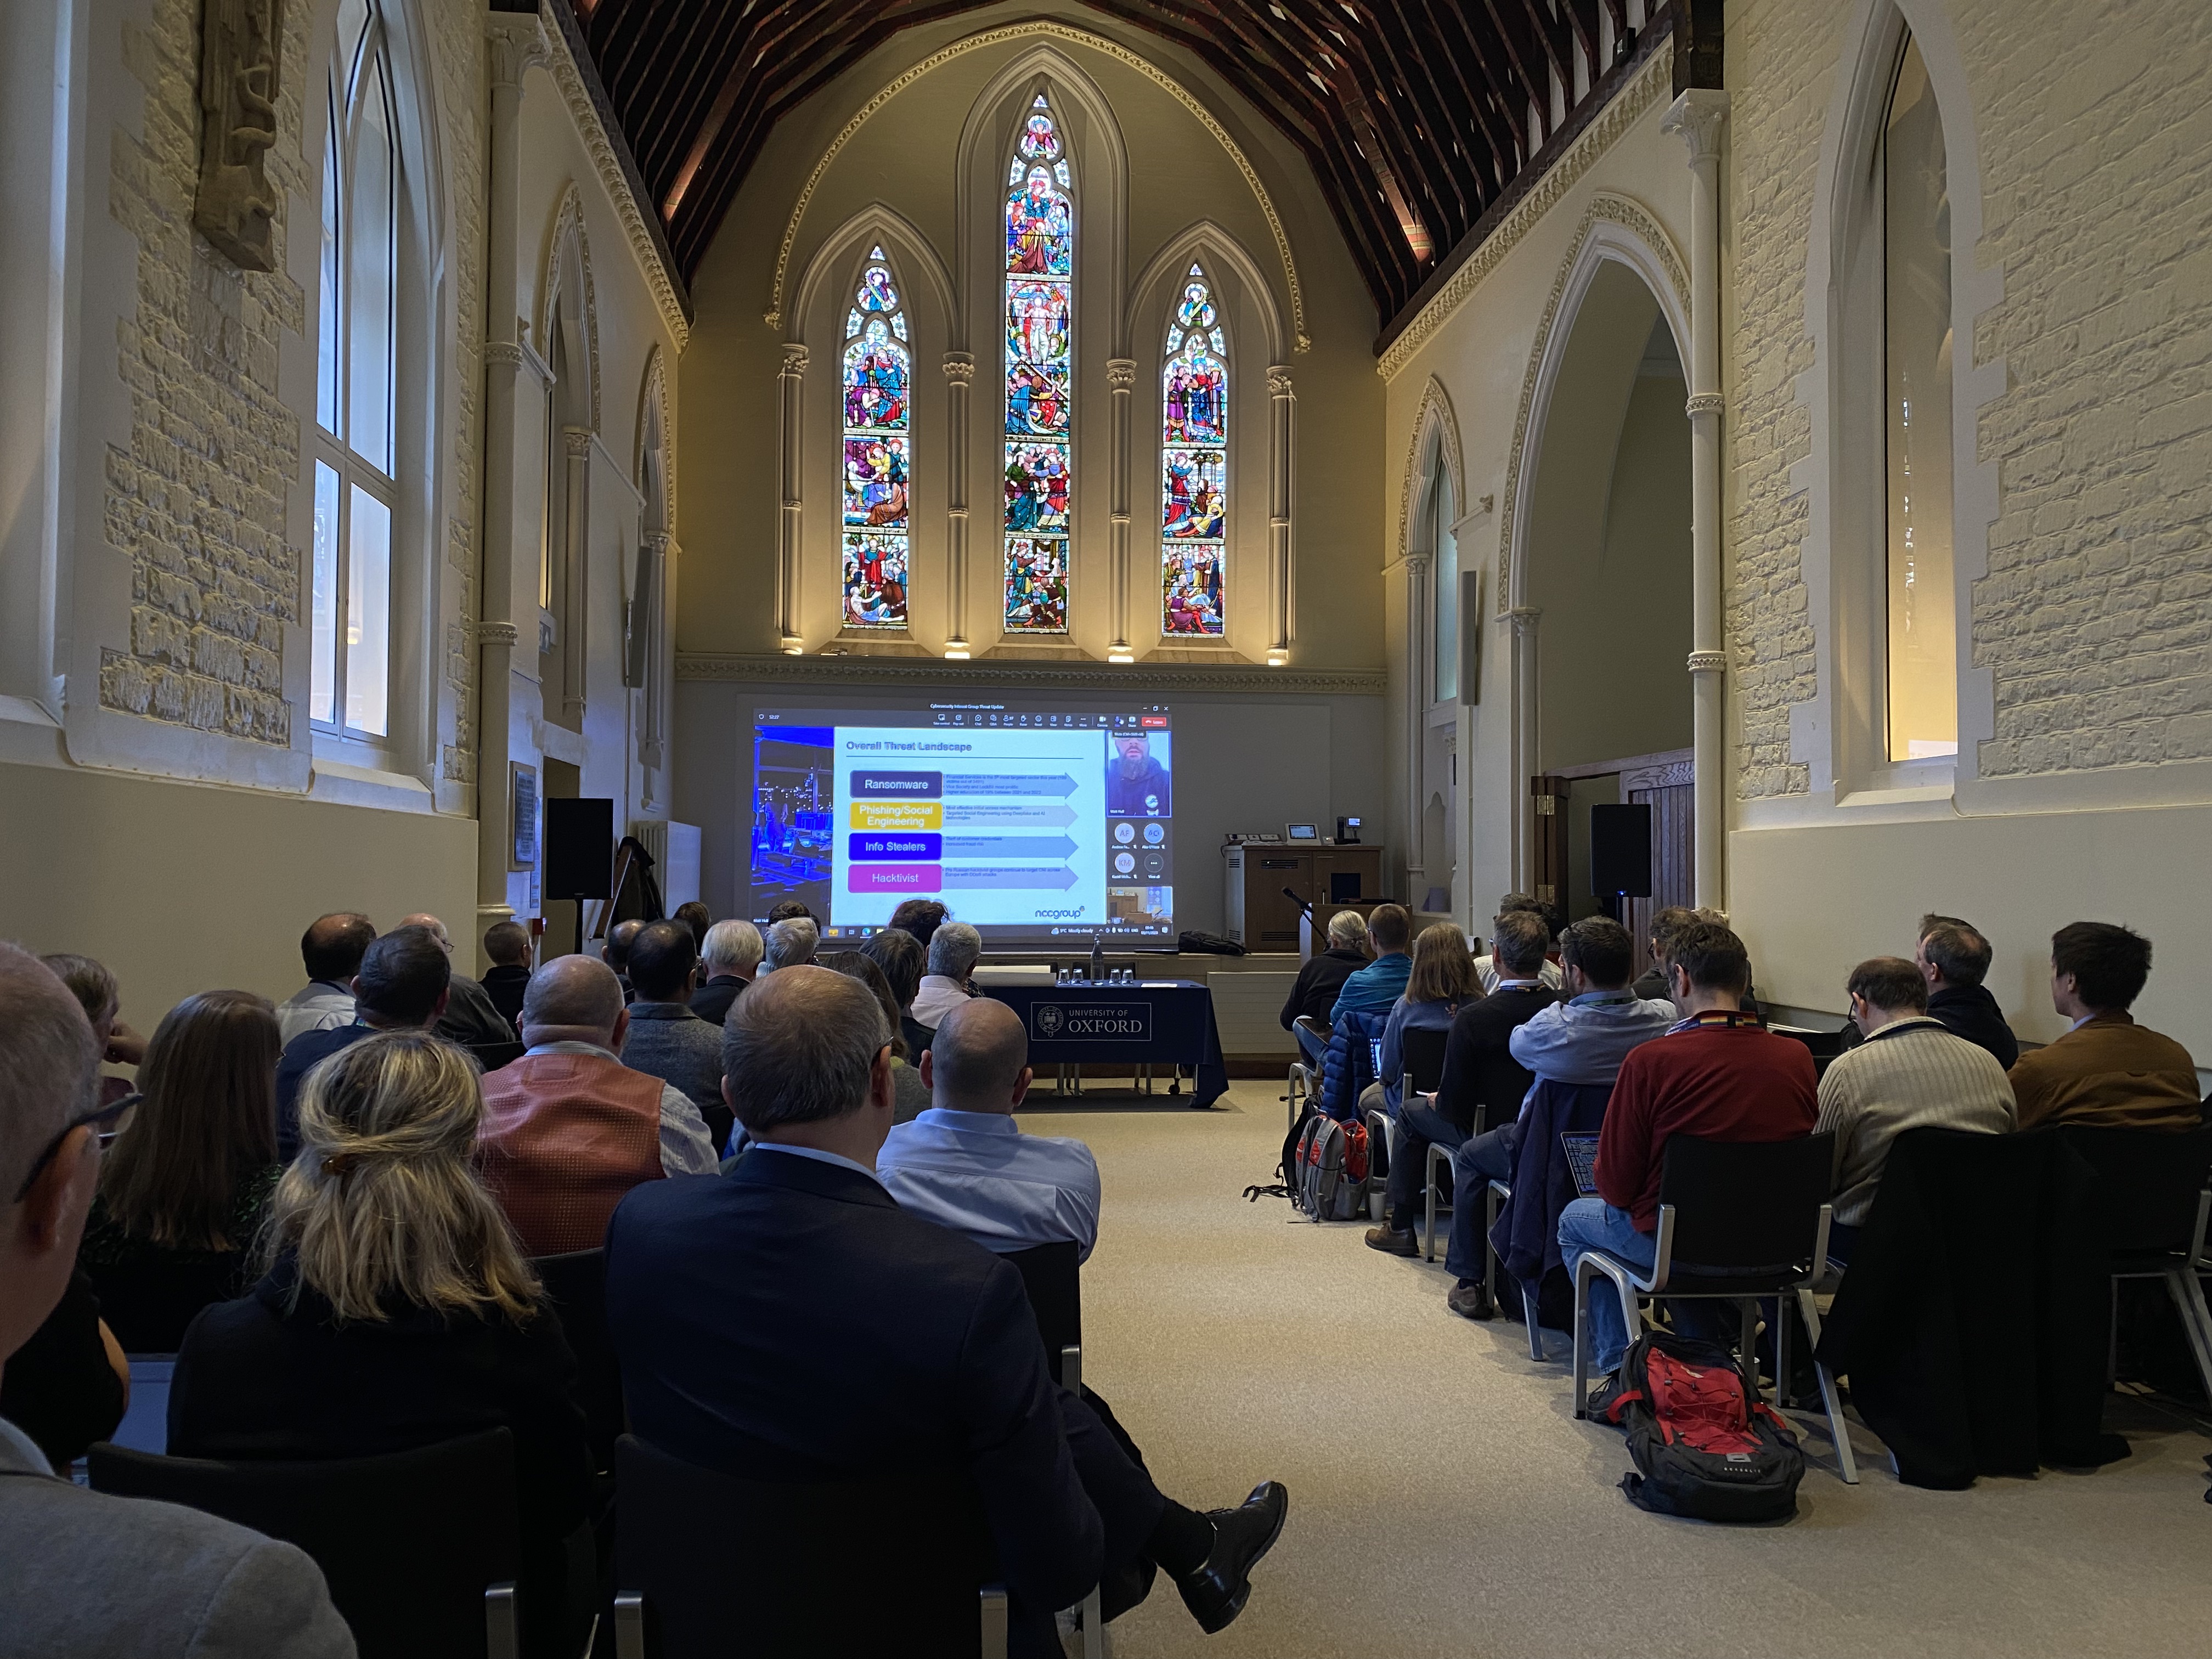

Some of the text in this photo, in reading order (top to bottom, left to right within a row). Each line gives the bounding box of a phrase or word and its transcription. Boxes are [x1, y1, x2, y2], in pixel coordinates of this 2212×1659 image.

[846, 741, 972, 753] Overall Threat Landscape
[865, 779, 928, 789] Ransomware
[859, 805, 933, 816] Phishing/Social
[867, 816, 924, 827] Engineering
[865, 842, 926, 851] Info Stealers
[872, 873, 919, 883] Hacktivist
[1035, 910, 1081, 919] nccgroup
[1069, 1019, 1142, 1033] OXFORD
